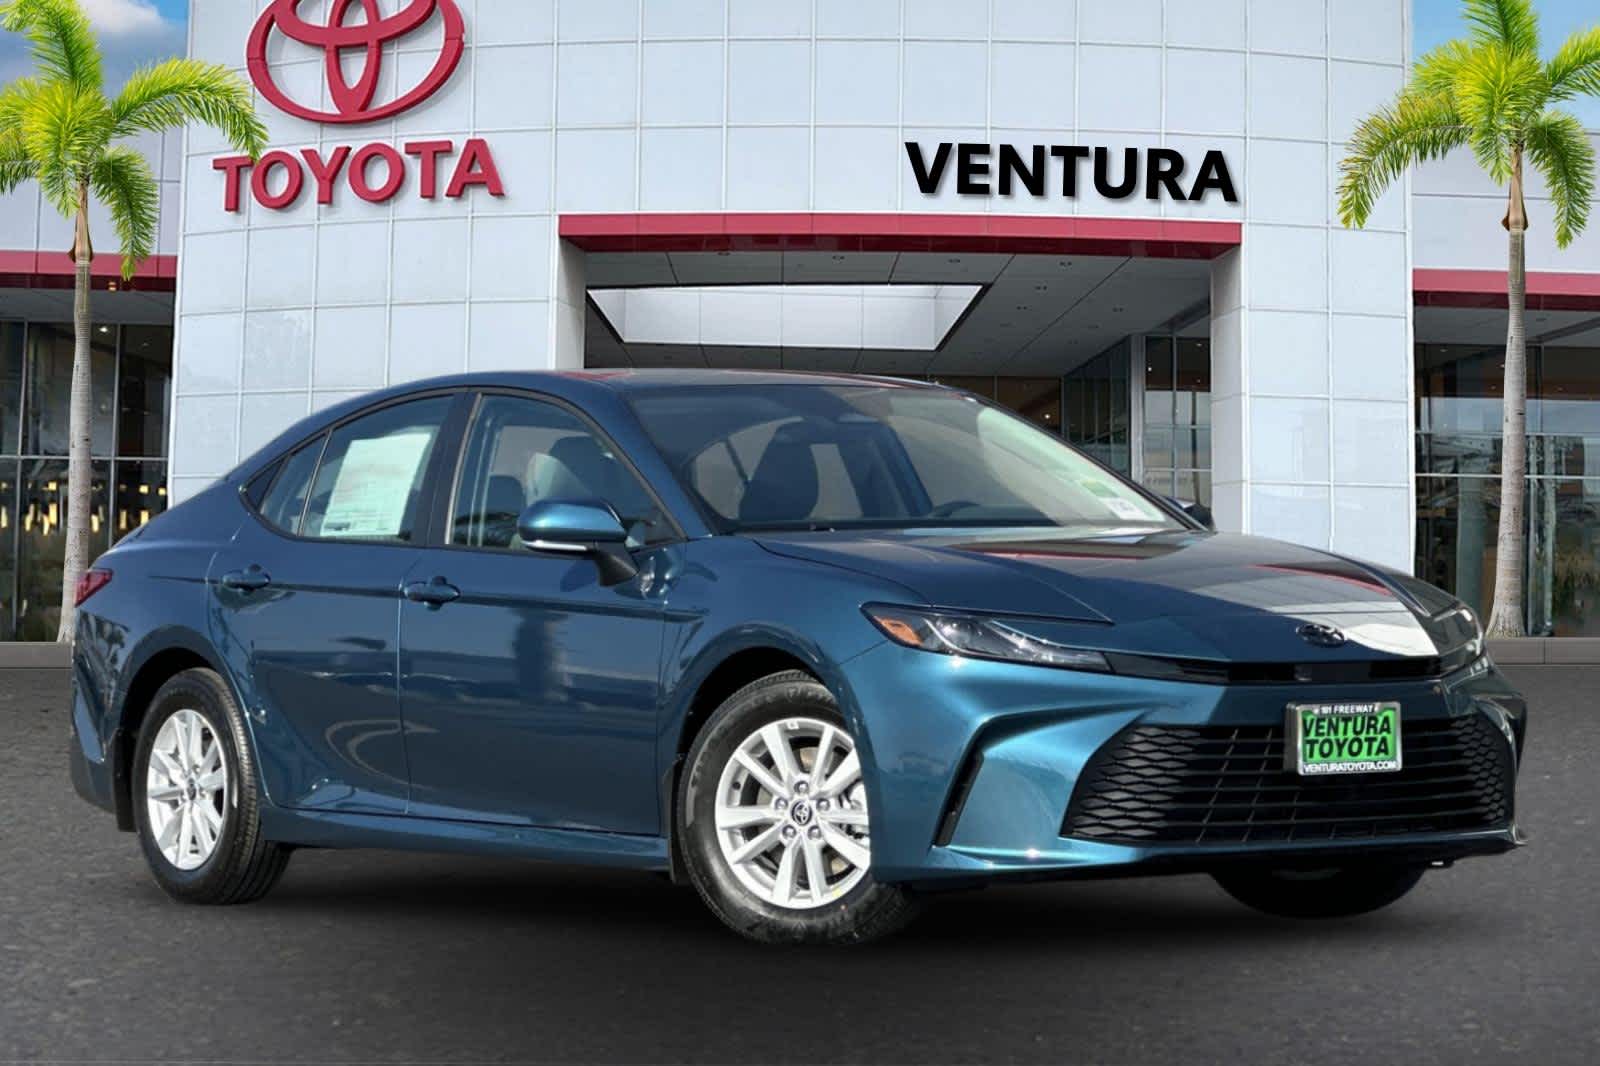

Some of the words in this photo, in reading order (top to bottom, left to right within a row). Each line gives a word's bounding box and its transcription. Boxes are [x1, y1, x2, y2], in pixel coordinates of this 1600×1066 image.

[213, 138, 505, 212] TOYOTA
[904, 141, 1239, 203] VENTURA
[1334, 704, 1374, 714] FREEWAY
[1302, 715, 1391, 737] VENTURA
[1305, 736, 1389, 759] TOYOTA
[1303, 760, 1397, 773] VENTURATOYOTA.COM
